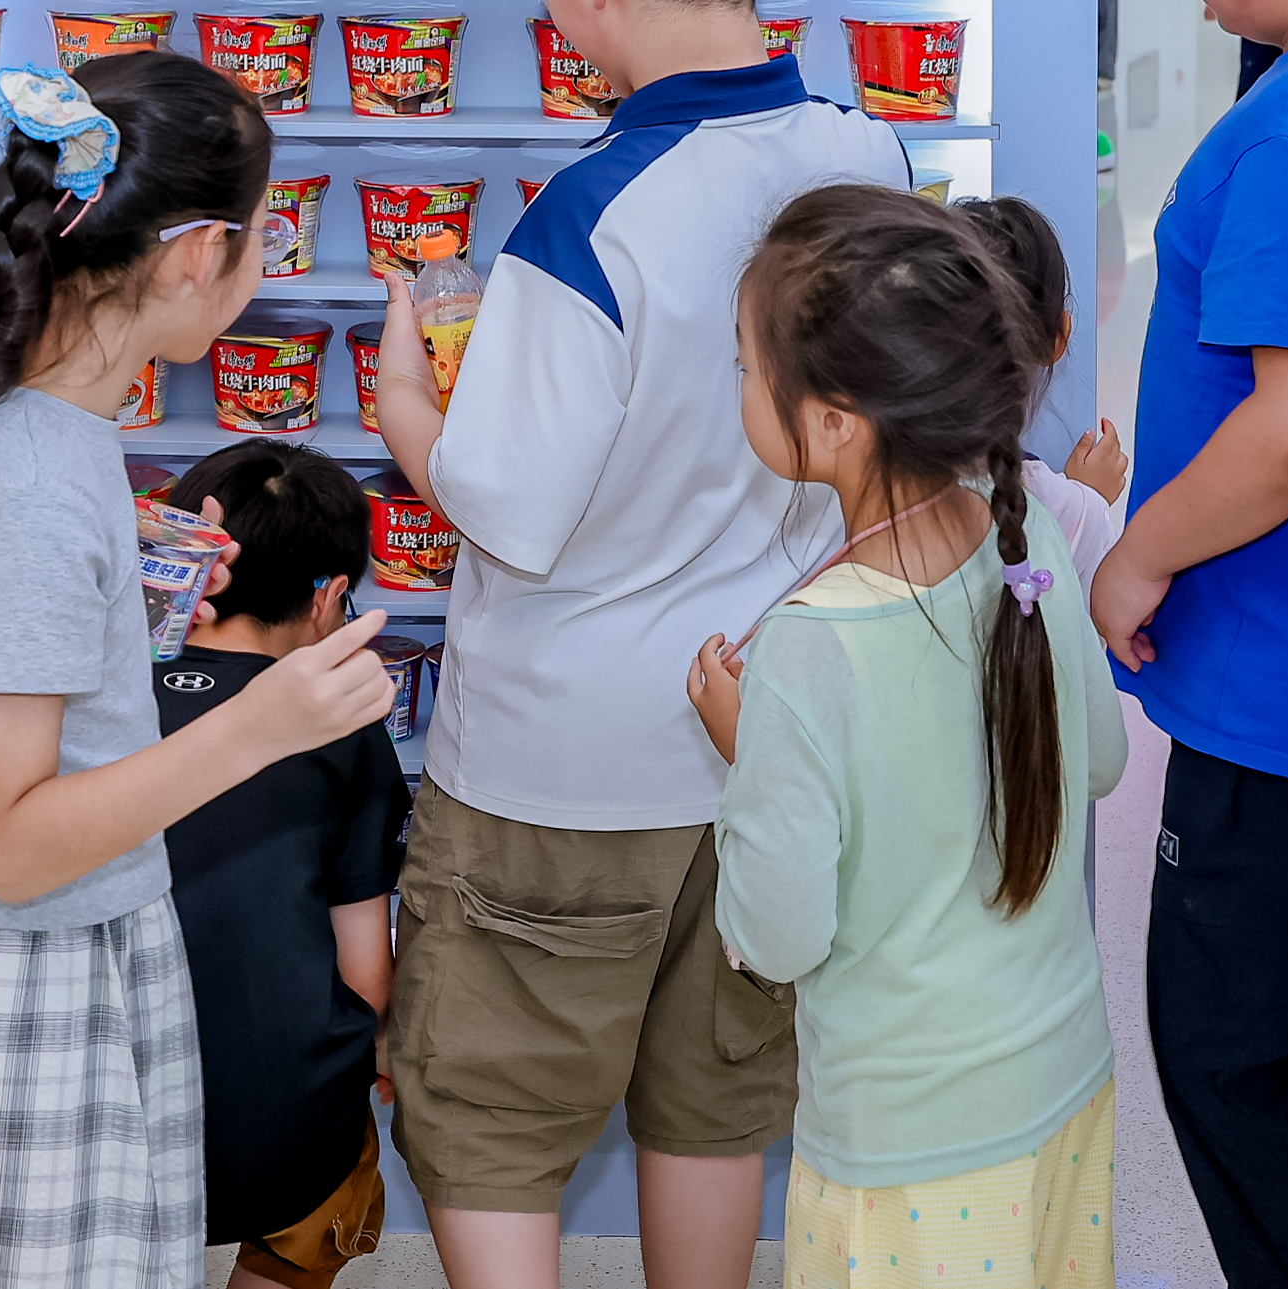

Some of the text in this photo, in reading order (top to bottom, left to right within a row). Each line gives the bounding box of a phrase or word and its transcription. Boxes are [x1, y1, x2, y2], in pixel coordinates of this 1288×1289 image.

[212, 52, 286, 69] 红烧牛肉面
[352, 54, 424, 73] 红烧牛肉面
[550, 56, 599, 76] 红烧牛
[218, 371, 291, 390] 红烧牛肉面
